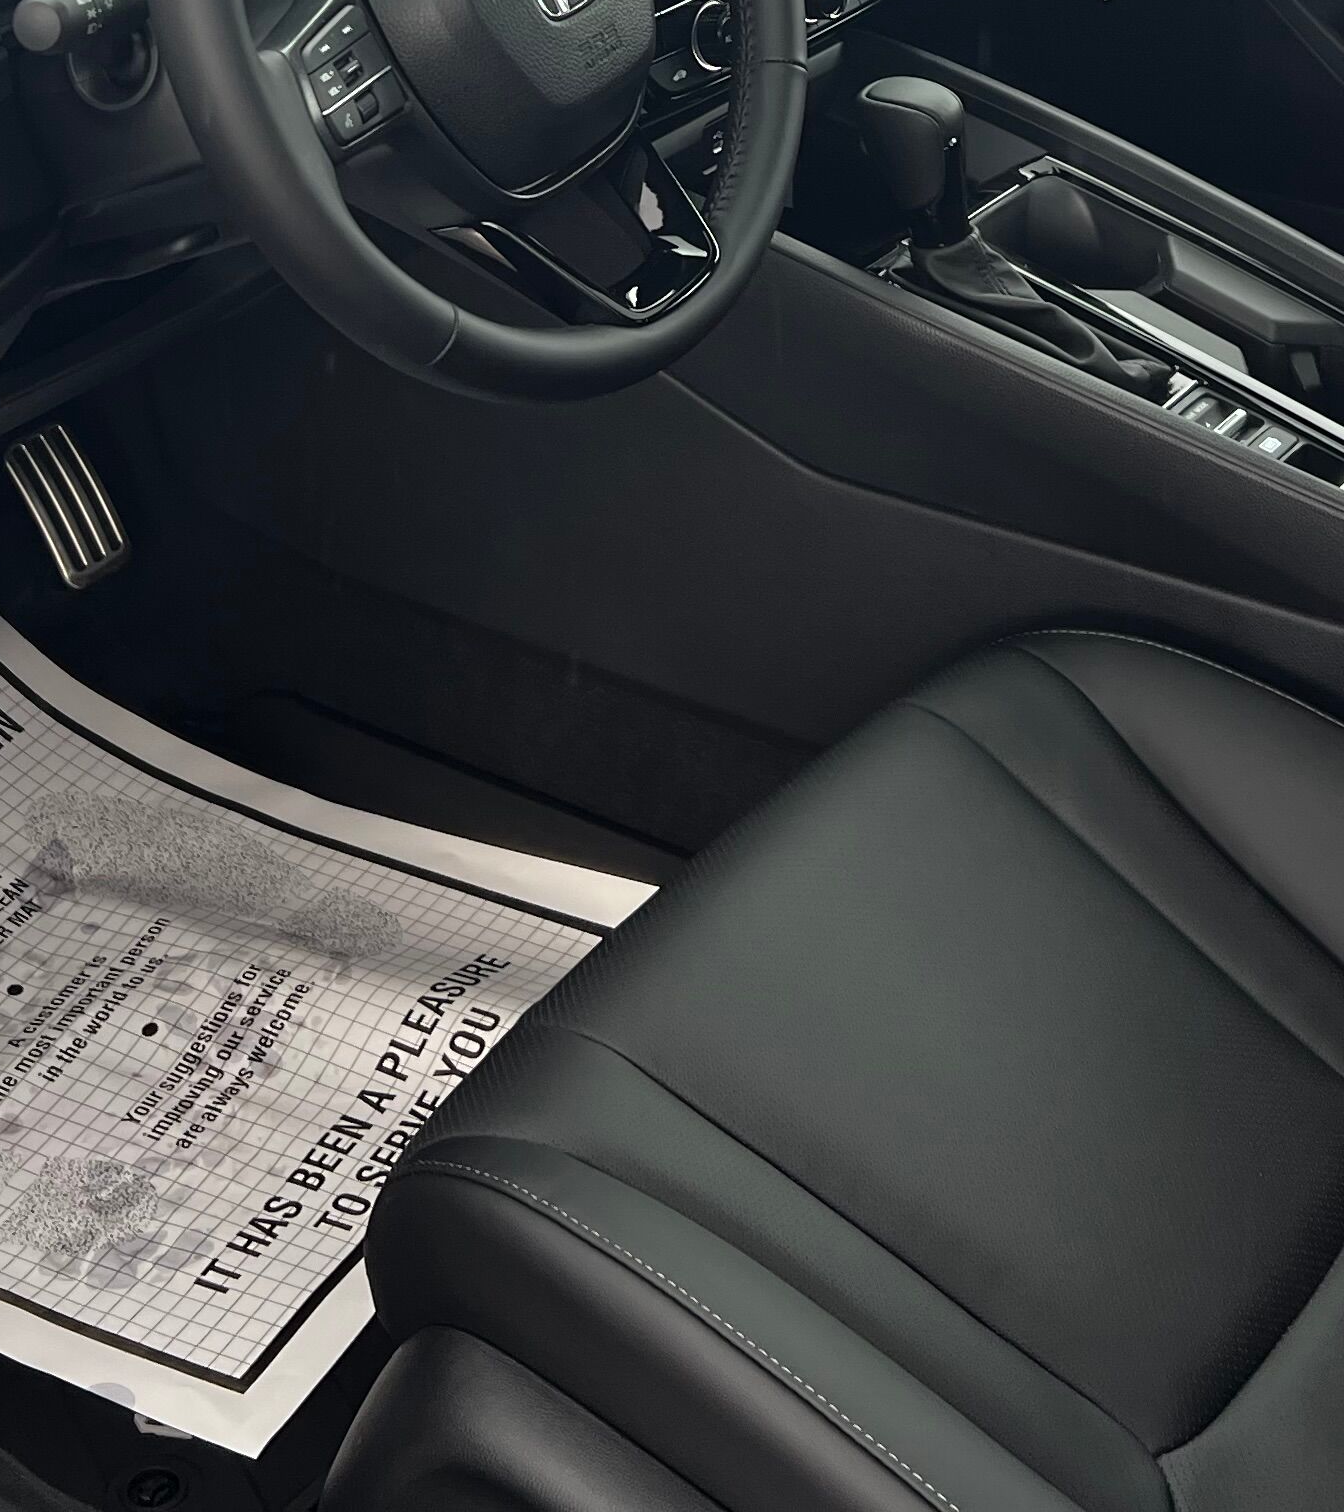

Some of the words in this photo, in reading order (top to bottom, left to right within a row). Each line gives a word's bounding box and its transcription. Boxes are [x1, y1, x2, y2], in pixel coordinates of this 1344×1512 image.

[7, 898, 43, 928] MAT
[8, 1037, 26, 1048] A
[23, 970, 91, 1034] customer
[85, 955, 107, 969] is
[14, 1034, 55, 1073] most
[48, 966, 123, 1032] important
[120, 917, 171, 966] person
[38, 1065, 63, 1083] in
[56, 1037, 88, 1064] the
[83, 991, 128, 1035] world
[122, 975, 144, 990] to
[141, 954, 169, 974] us.
[121, 1090, 163, 1125] Your
[159, 991, 243, 1091] suggestions
[233, 964, 262, 987] for
[143, 1064, 224, 1141] improving
[216, 1030, 244, 1061] our
[241, 968, 292, 1028] service
[375, 954, 511, 1081] PLEASURE
[176, 1122, 205, 1149] are
[202, 1067, 254, 1122] always
[248, 981, 315, 1063] welcome.
[313, 1192, 372, 1231] TO
[356, 1090, 441, 1188] SERVE
[433, 1006, 502, 1080] YOU
[356, 1089, 396, 1115] A
[286, 1114, 373, 1191] BEEN
[193, 1258, 242, 1294] IT
[226, 1195, 303, 1257] HAS
